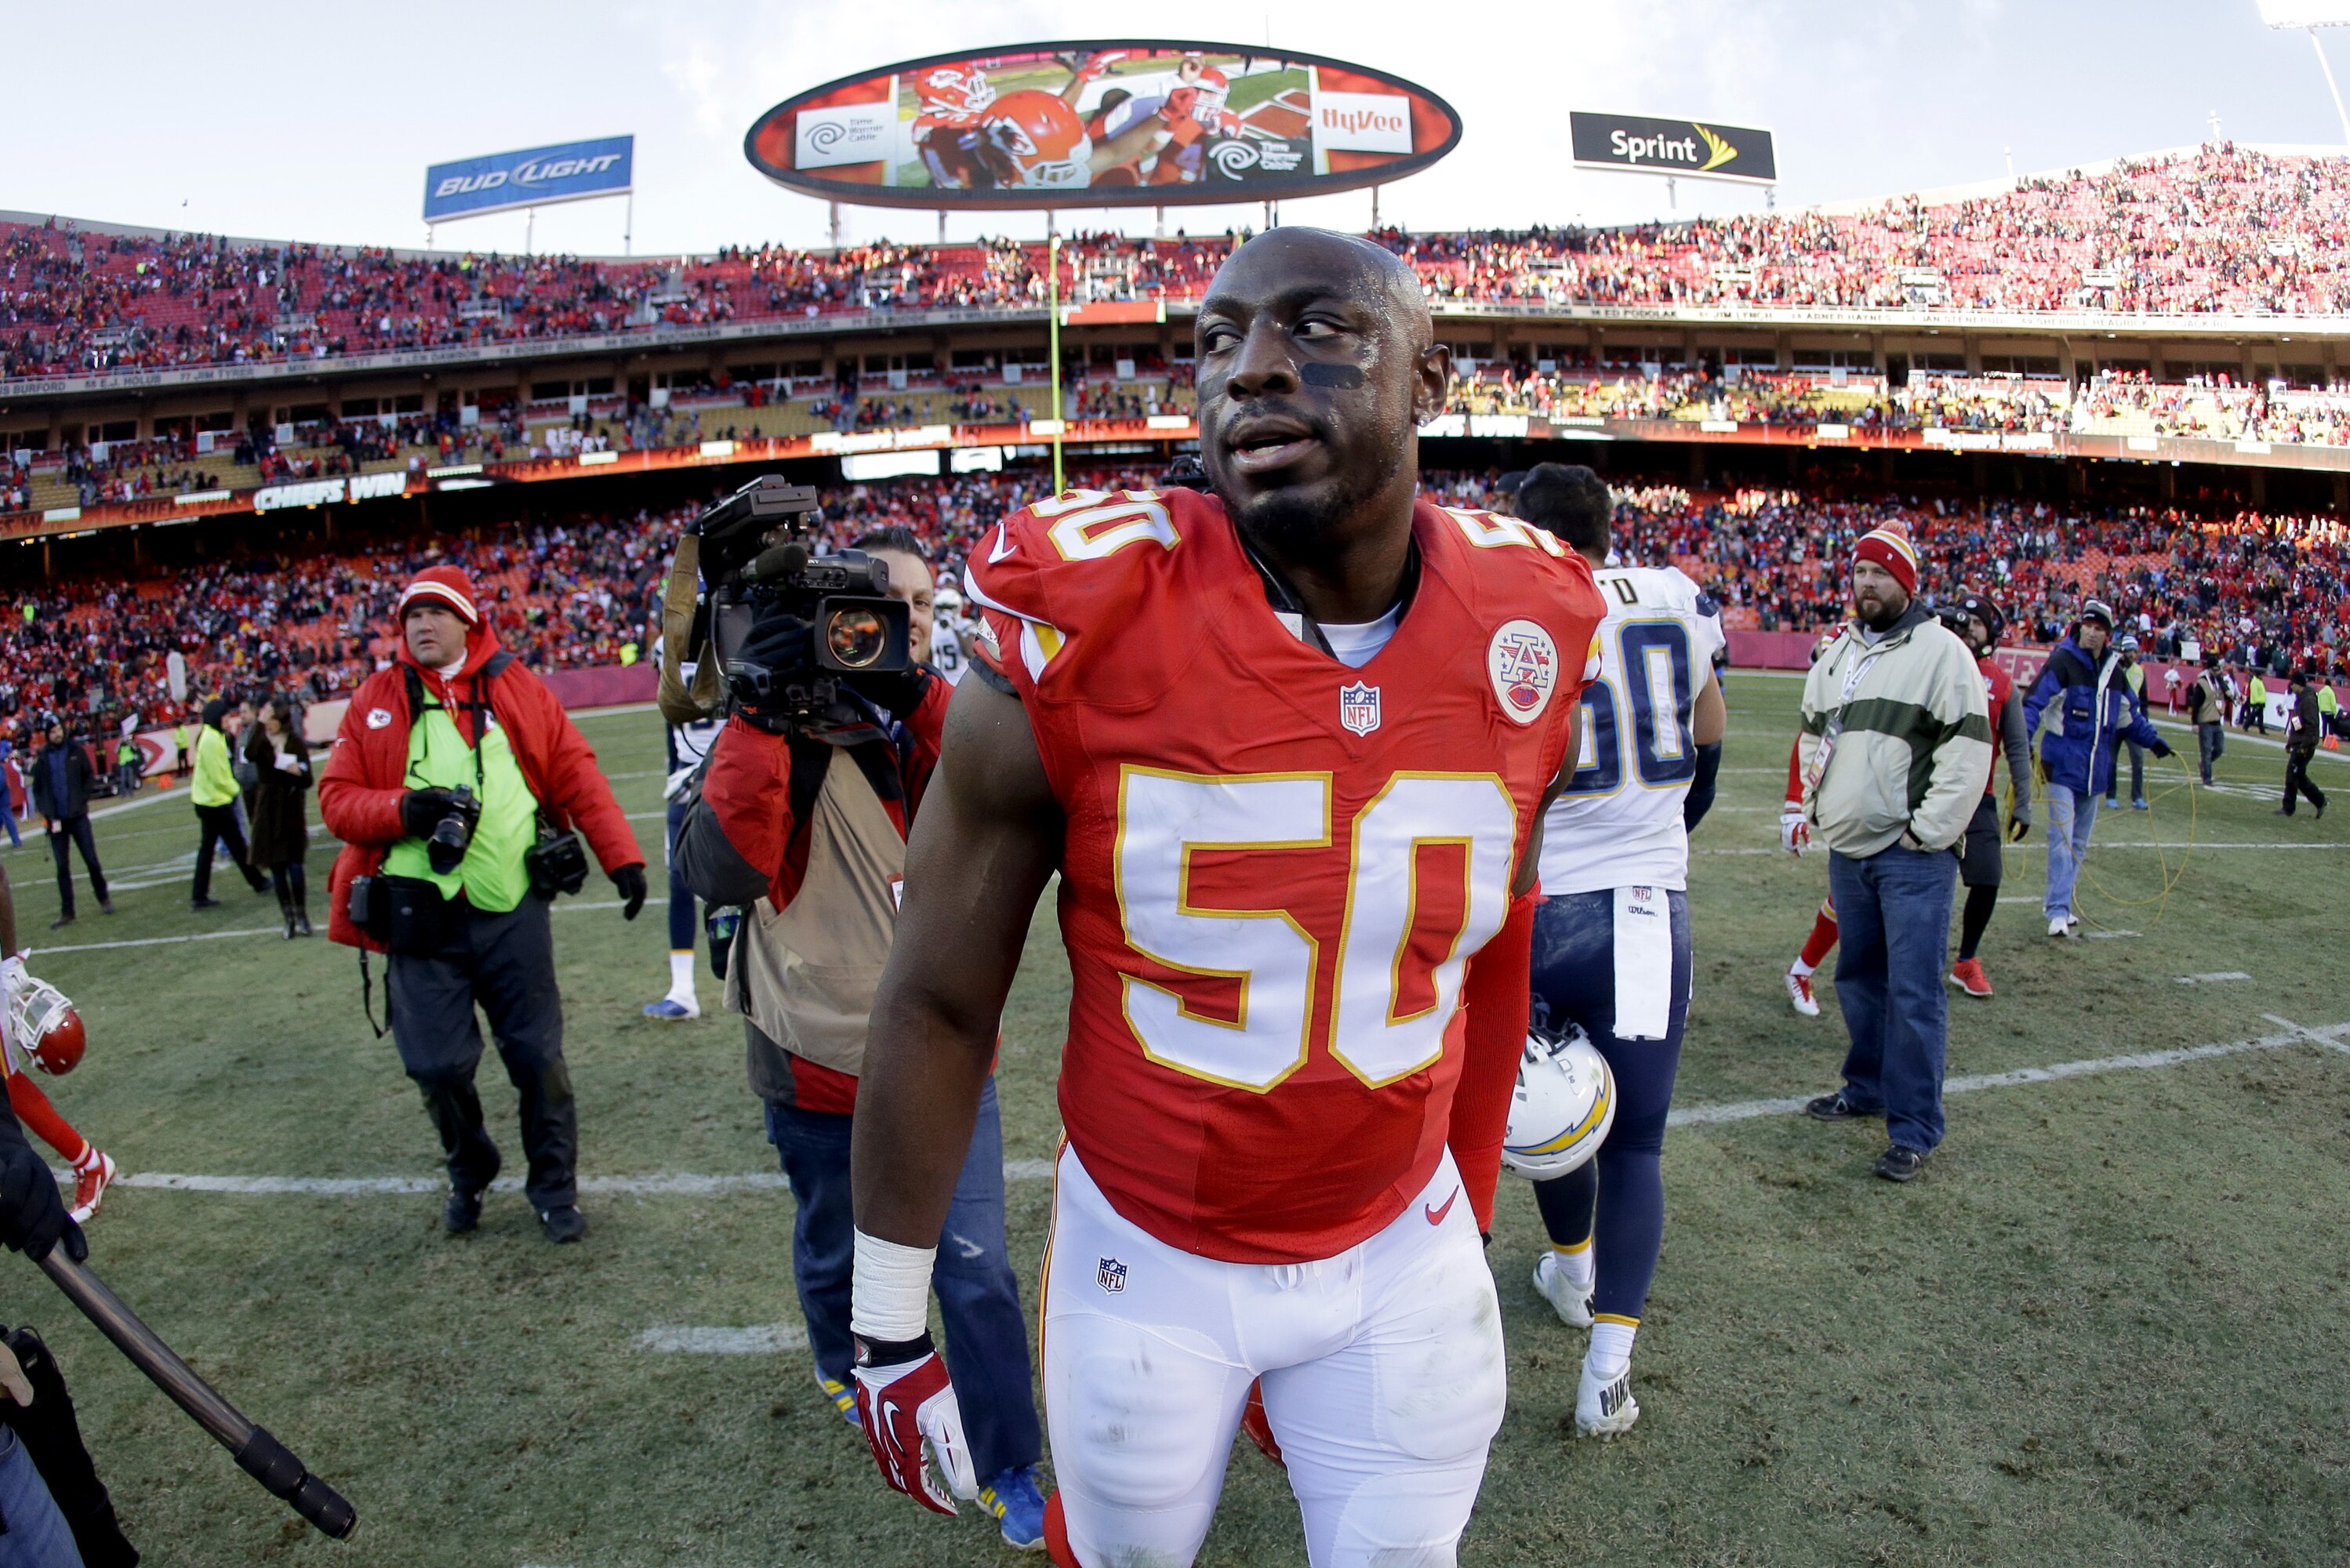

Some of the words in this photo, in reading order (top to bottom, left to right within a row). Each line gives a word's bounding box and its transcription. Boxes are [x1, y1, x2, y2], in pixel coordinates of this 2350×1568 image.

[1322, 108, 1403, 135] HyVee
[1610, 129, 1698, 163] Sprint
[435, 171, 509, 198] BUD
[519, 154, 622, 183] LIGHT
[253, 477, 346, 510] CHIEFS
[350, 470, 408, 500] WIN
[1346, 706, 1375, 728] NFL
[1633, 887, 1650, 902] NFL
[1627, 905, 1658, 917] Wilson
[1113, 763, 1519, 1095] 50
[1099, 1269, 1122, 1290] NFL
